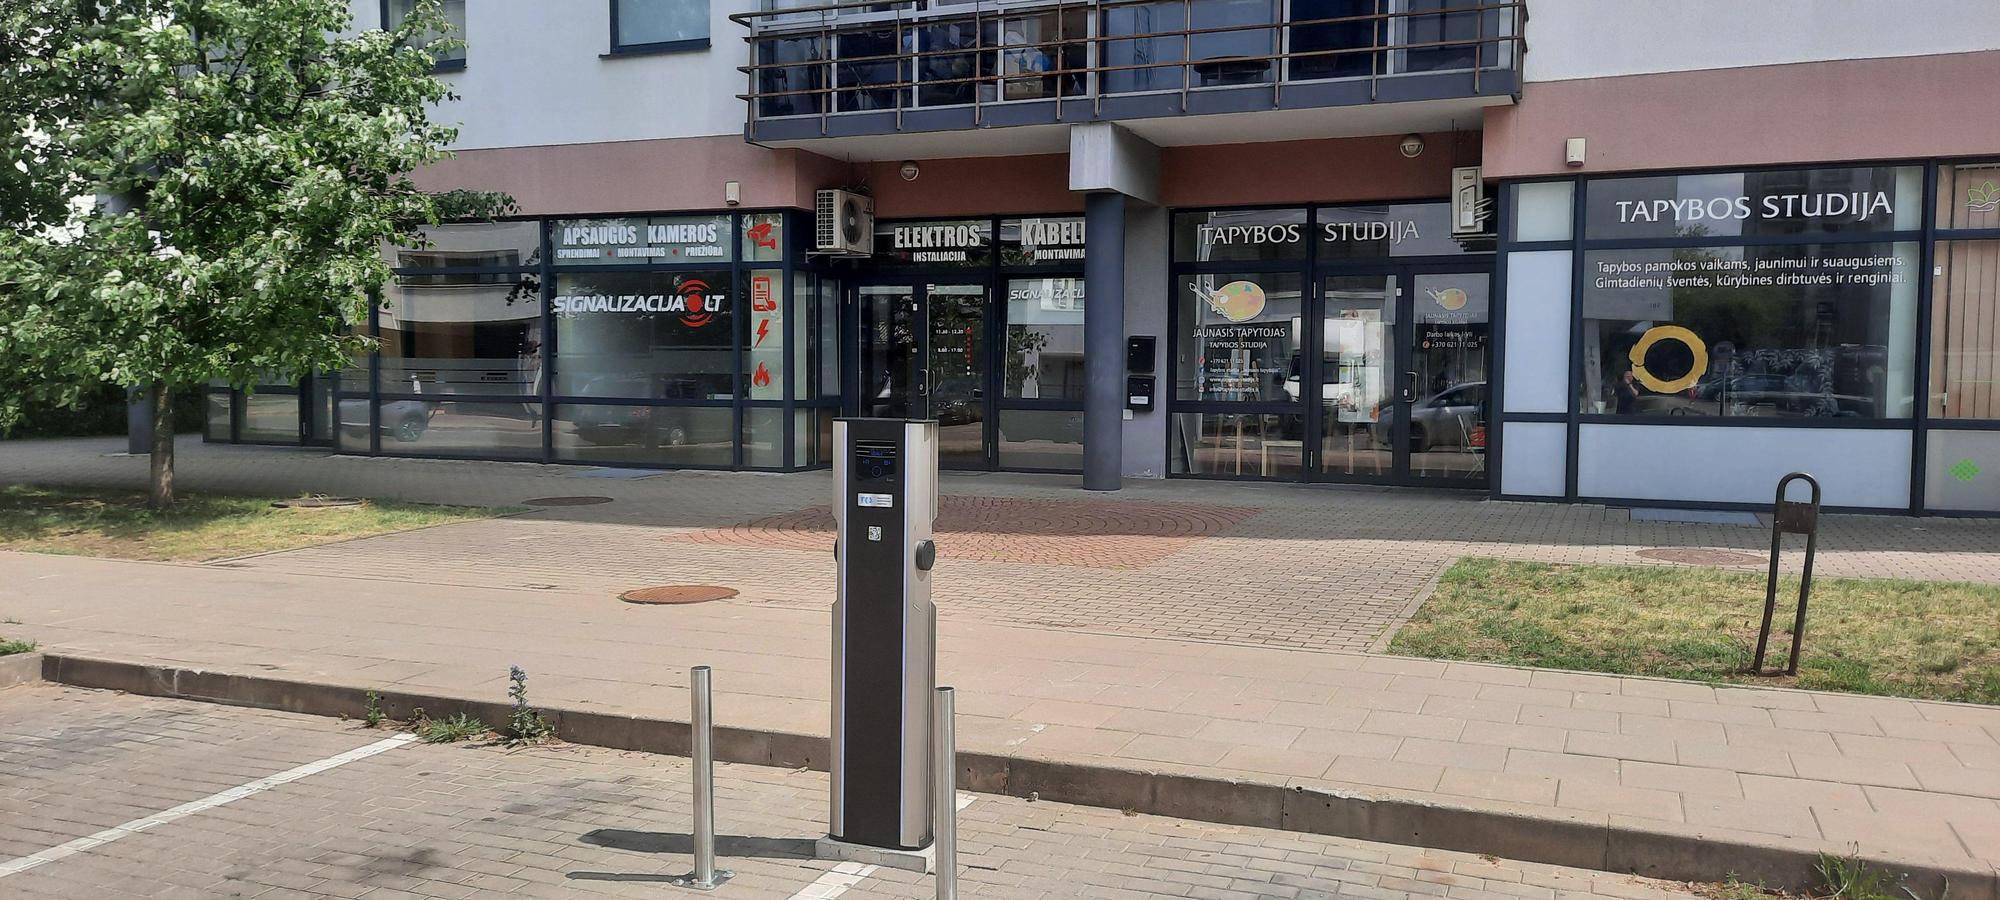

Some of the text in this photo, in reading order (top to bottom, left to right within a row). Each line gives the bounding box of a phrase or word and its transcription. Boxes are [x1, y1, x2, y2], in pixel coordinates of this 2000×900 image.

[1616, 191, 1894, 223] TAPYBOS STUDIJA
[563, 223, 717, 245] APSAUGOS KAMEROS
[894, 225, 980, 248] ELEKTROS
[1201, 220, 1420, 245] TAPYBOS STUDIJA
[557, 248, 600, 259] SPRENDIMAI
[617, 247, 666, 258] MONTAVIMAS
[913, 250, 966, 263] INSTALIACIJA
[1597, 254, 1906, 275] Tapybos pamokos vaikams, jaunimui ir suaugusiems.
[1596, 274, 1663, 290] Gimtadienių
[1717, 273, 1773, 289] kūrybines
[1777, 271, 1832, 286] dirbtuvės
[1836, 271, 1845, 284] ir
[1848, 270, 1907, 287] renginiai.
[1192, 327, 1286, 338] JAUNASIS TAPYTOJAS
[1209, 341, 1268, 350] TAPYBOS STUDIJA
